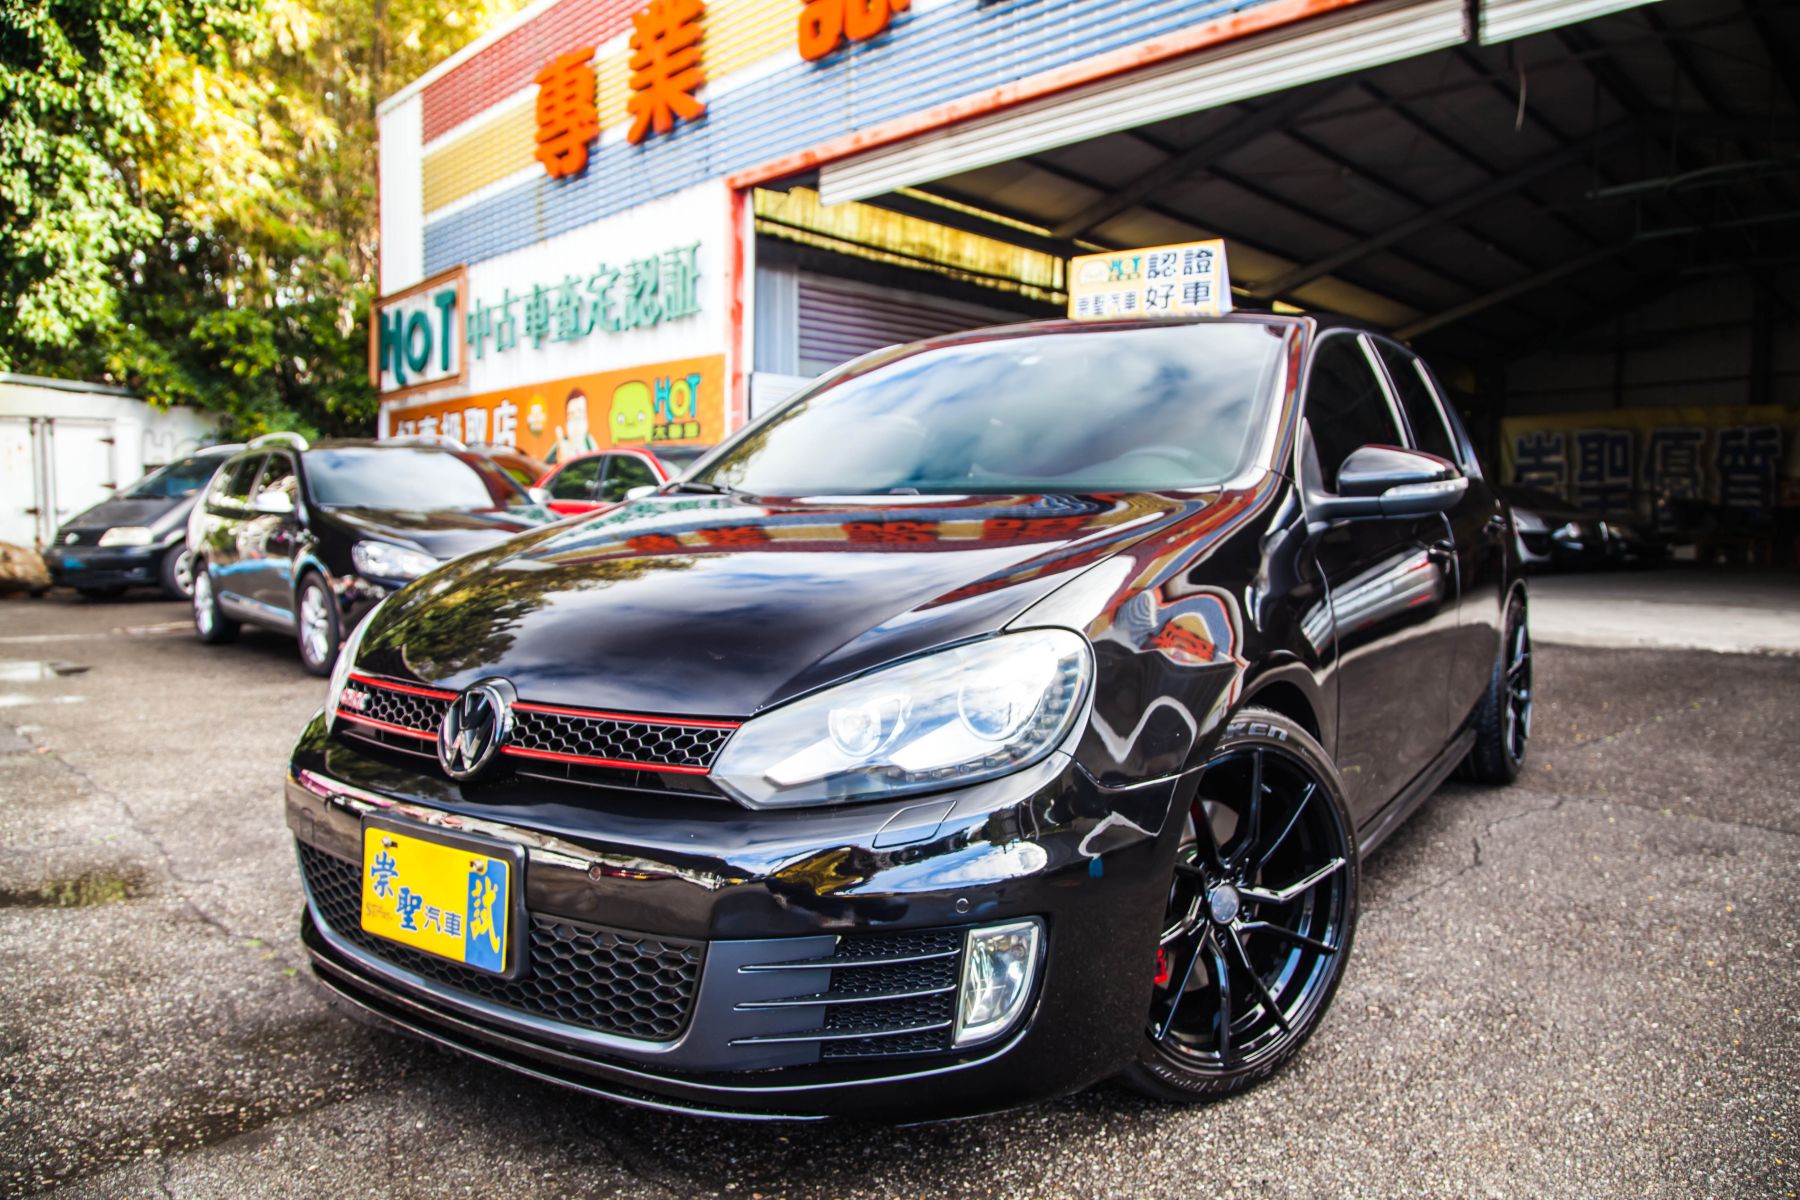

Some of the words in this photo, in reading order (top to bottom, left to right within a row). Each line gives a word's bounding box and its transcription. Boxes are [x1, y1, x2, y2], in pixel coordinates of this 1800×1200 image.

[1148, 249, 1213, 279] 認證
[1146, 280, 1211, 310] 好車
[381, 289, 456, 386] HOT
[654, 373, 702, 423] HOT
[1222, 721, 1289, 742] KEN
